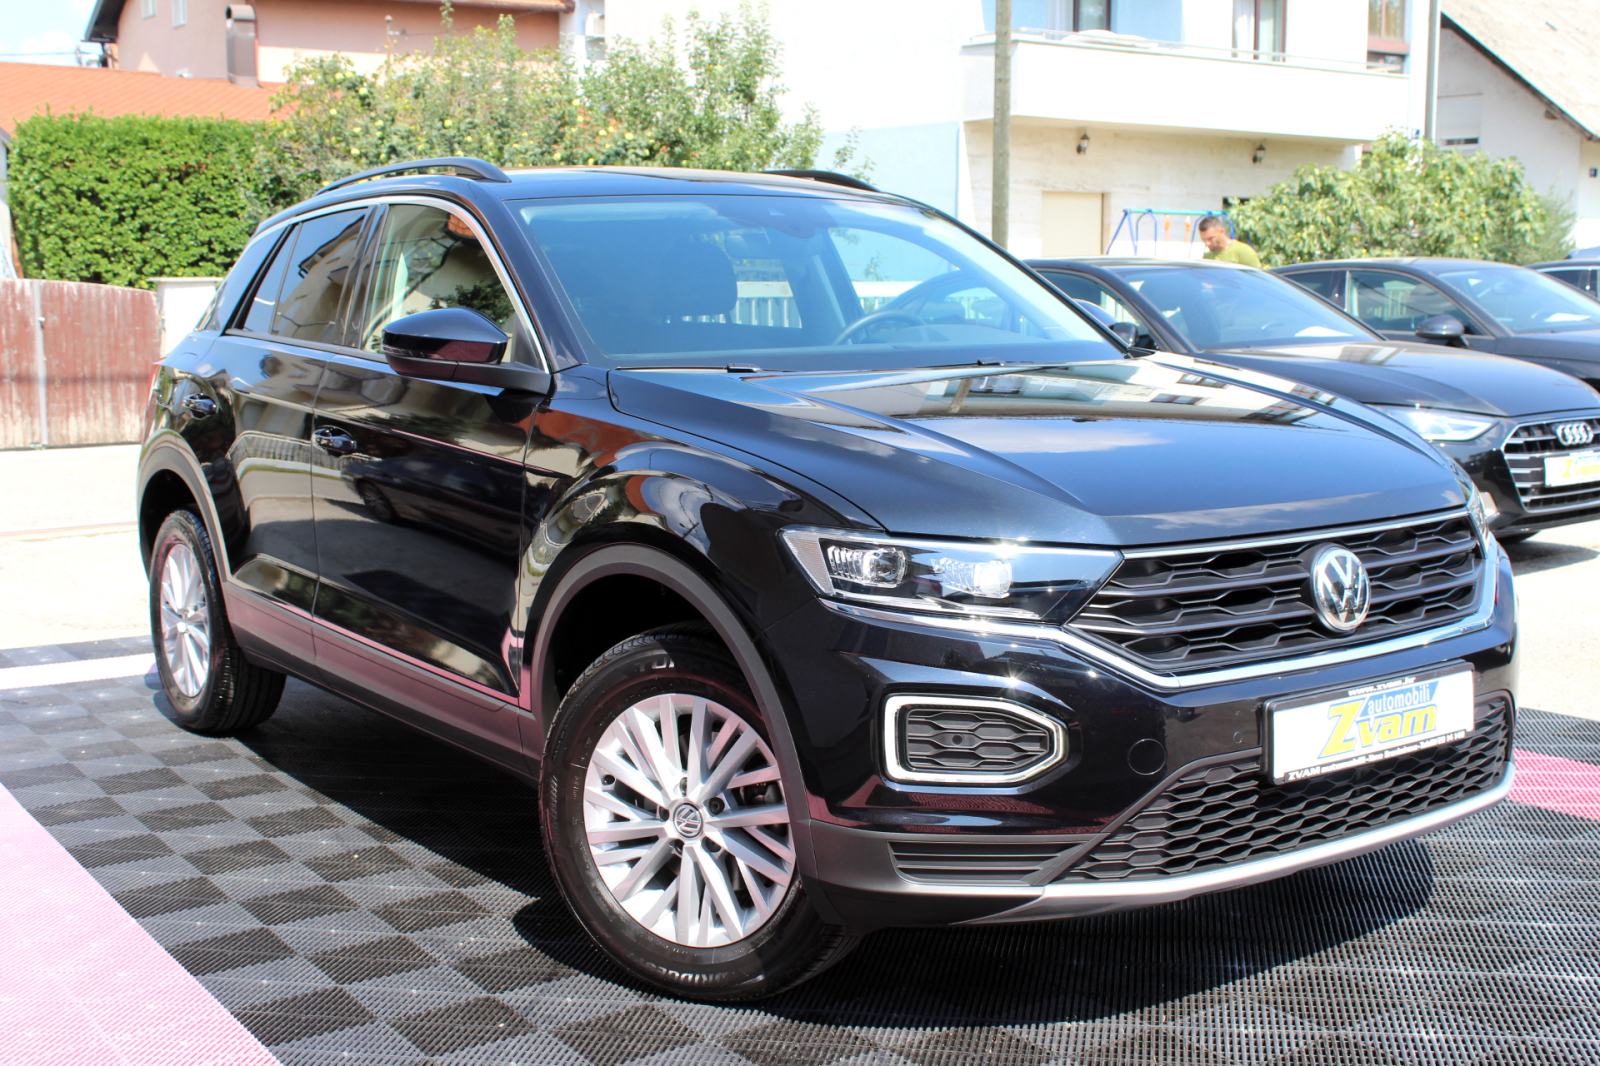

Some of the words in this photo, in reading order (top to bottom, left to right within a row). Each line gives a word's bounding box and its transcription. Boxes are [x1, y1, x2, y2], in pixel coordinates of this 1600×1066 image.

[1368, 683, 1430, 715] automobili
[1318, 700, 1436, 758] Zvam
[1288, 766, 1321, 781] ZVAM
